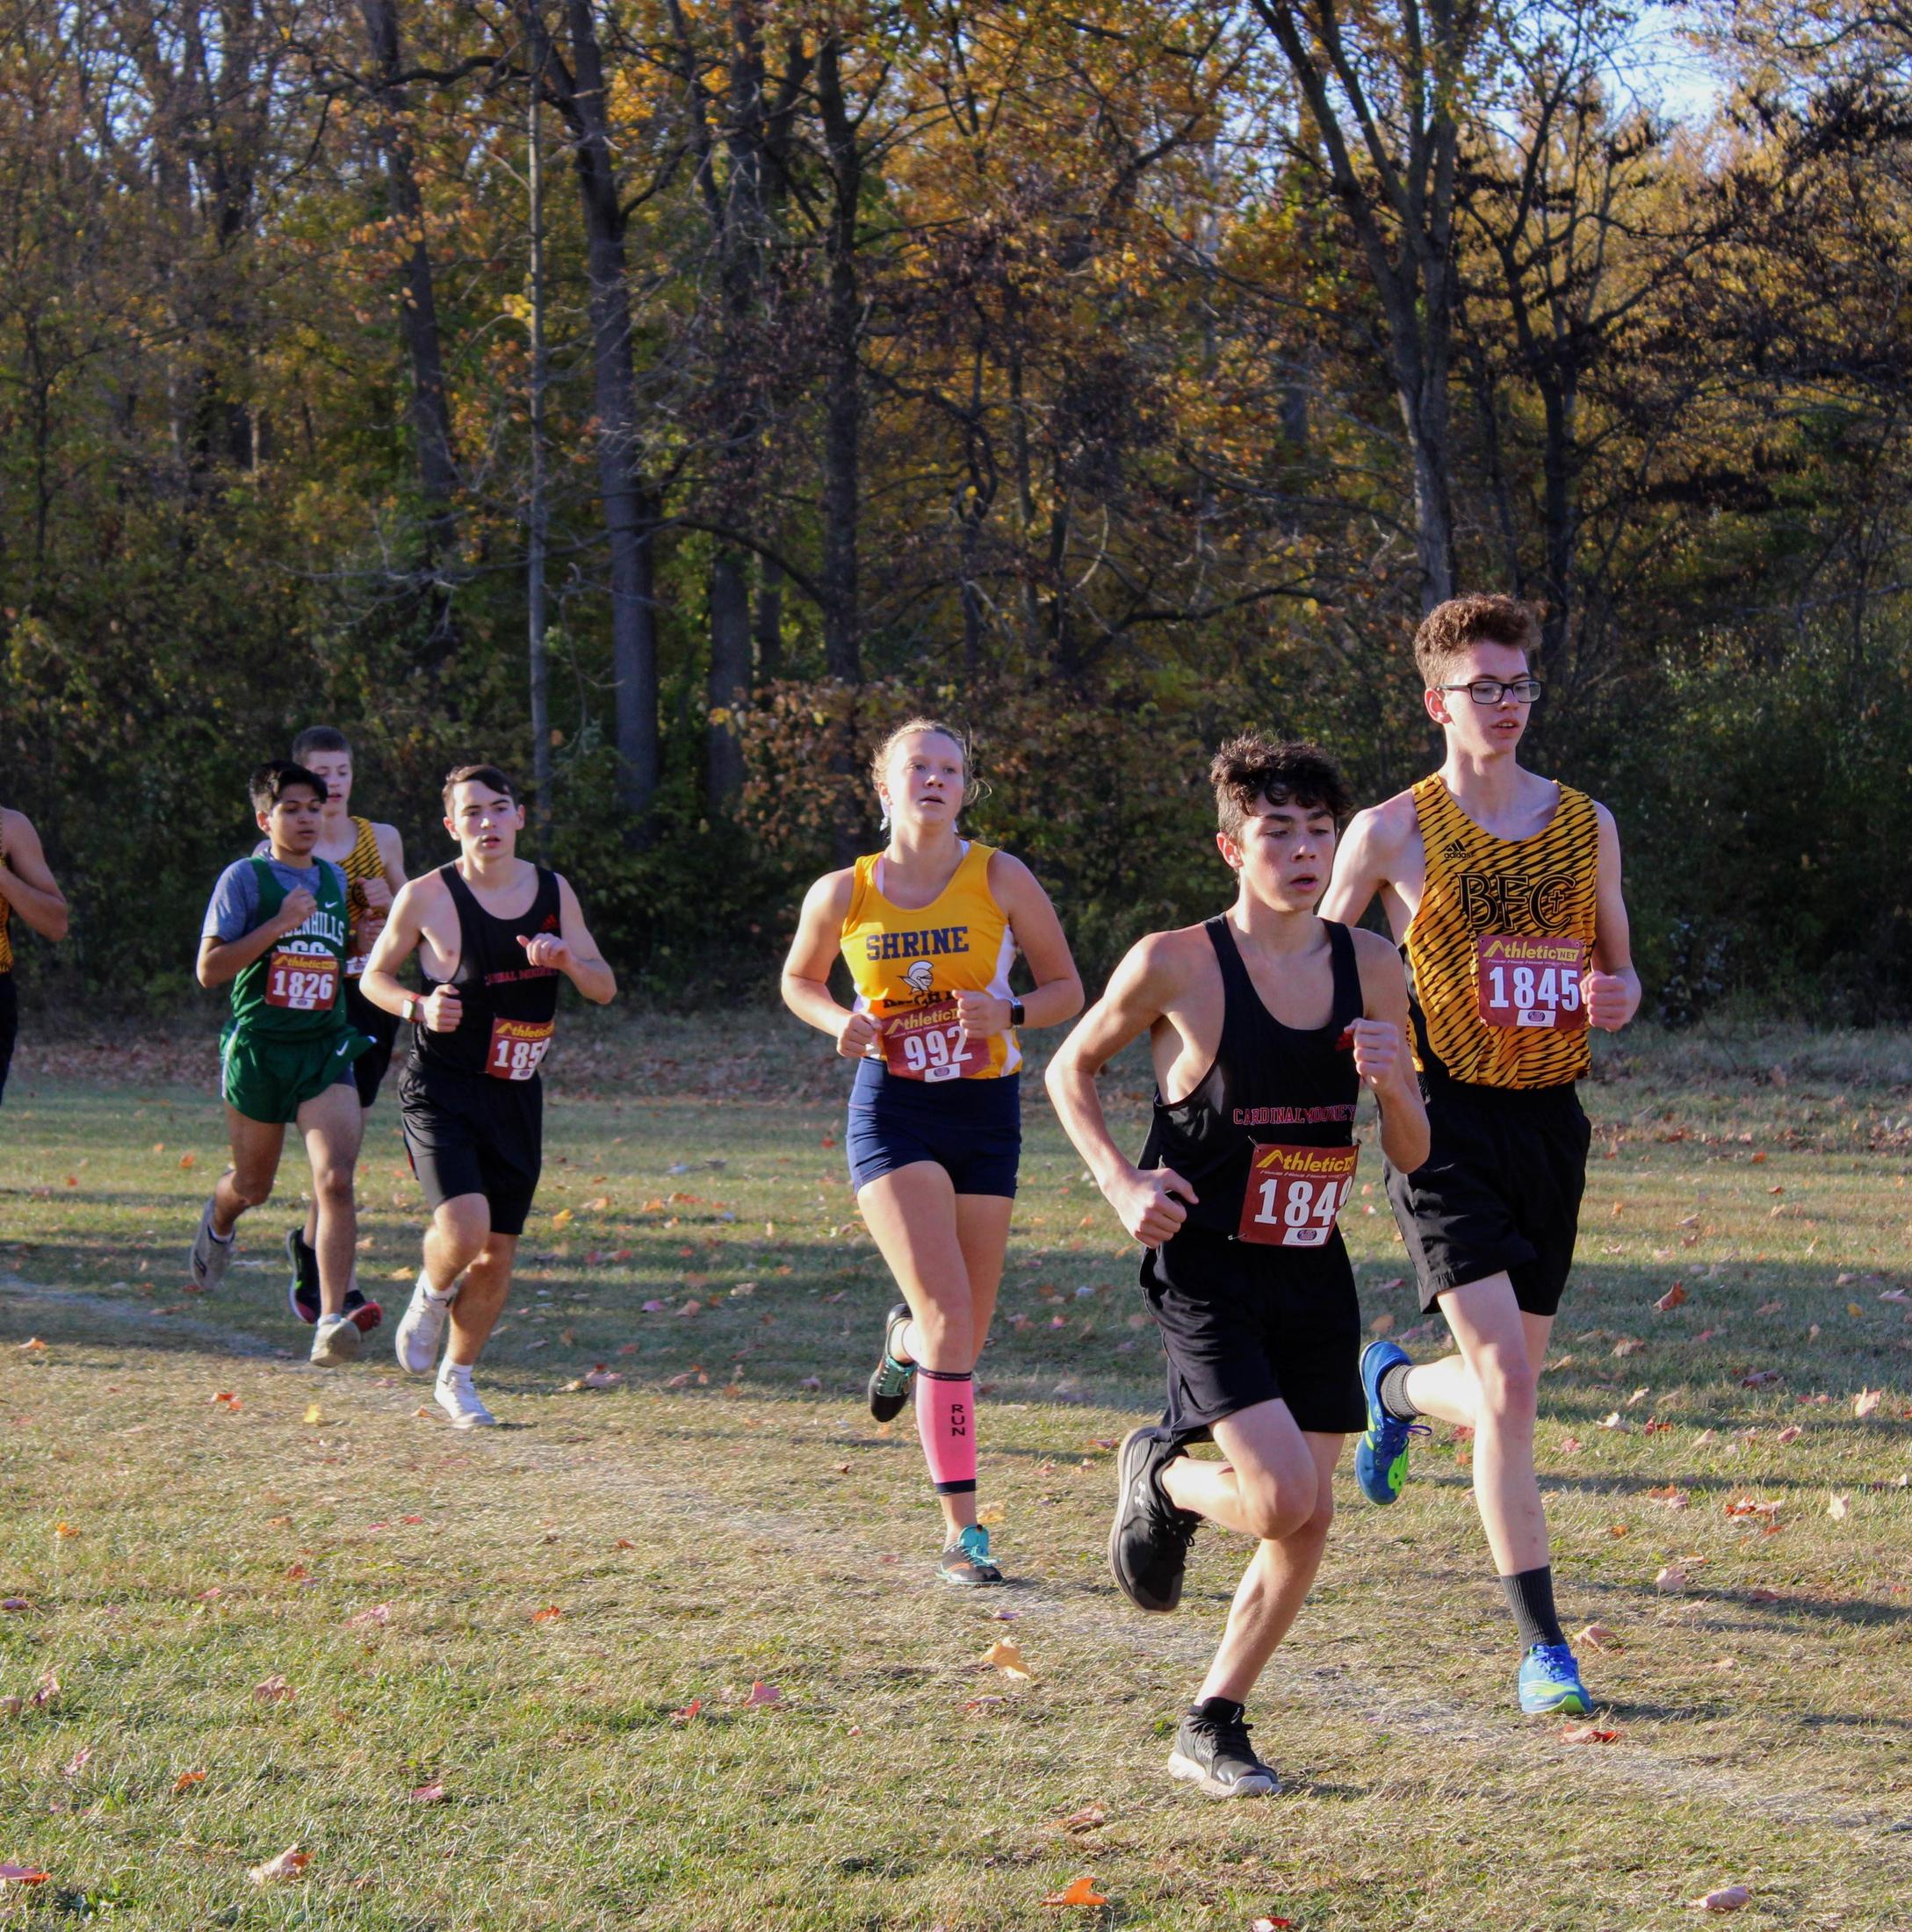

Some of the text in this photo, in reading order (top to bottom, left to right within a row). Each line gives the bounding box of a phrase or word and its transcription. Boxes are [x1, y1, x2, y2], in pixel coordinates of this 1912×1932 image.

[1455, 872, 1576, 932] BFC
[866, 926, 970, 961] SHRINE
[272, 970, 334, 1000] 1826
[1489, 966, 1579, 1012] 1845
[904, 1026, 973, 1071] 992
[1233, 1107, 1305, 1126] CARDINAL
[951, 1404, 965, 1437] RUN
